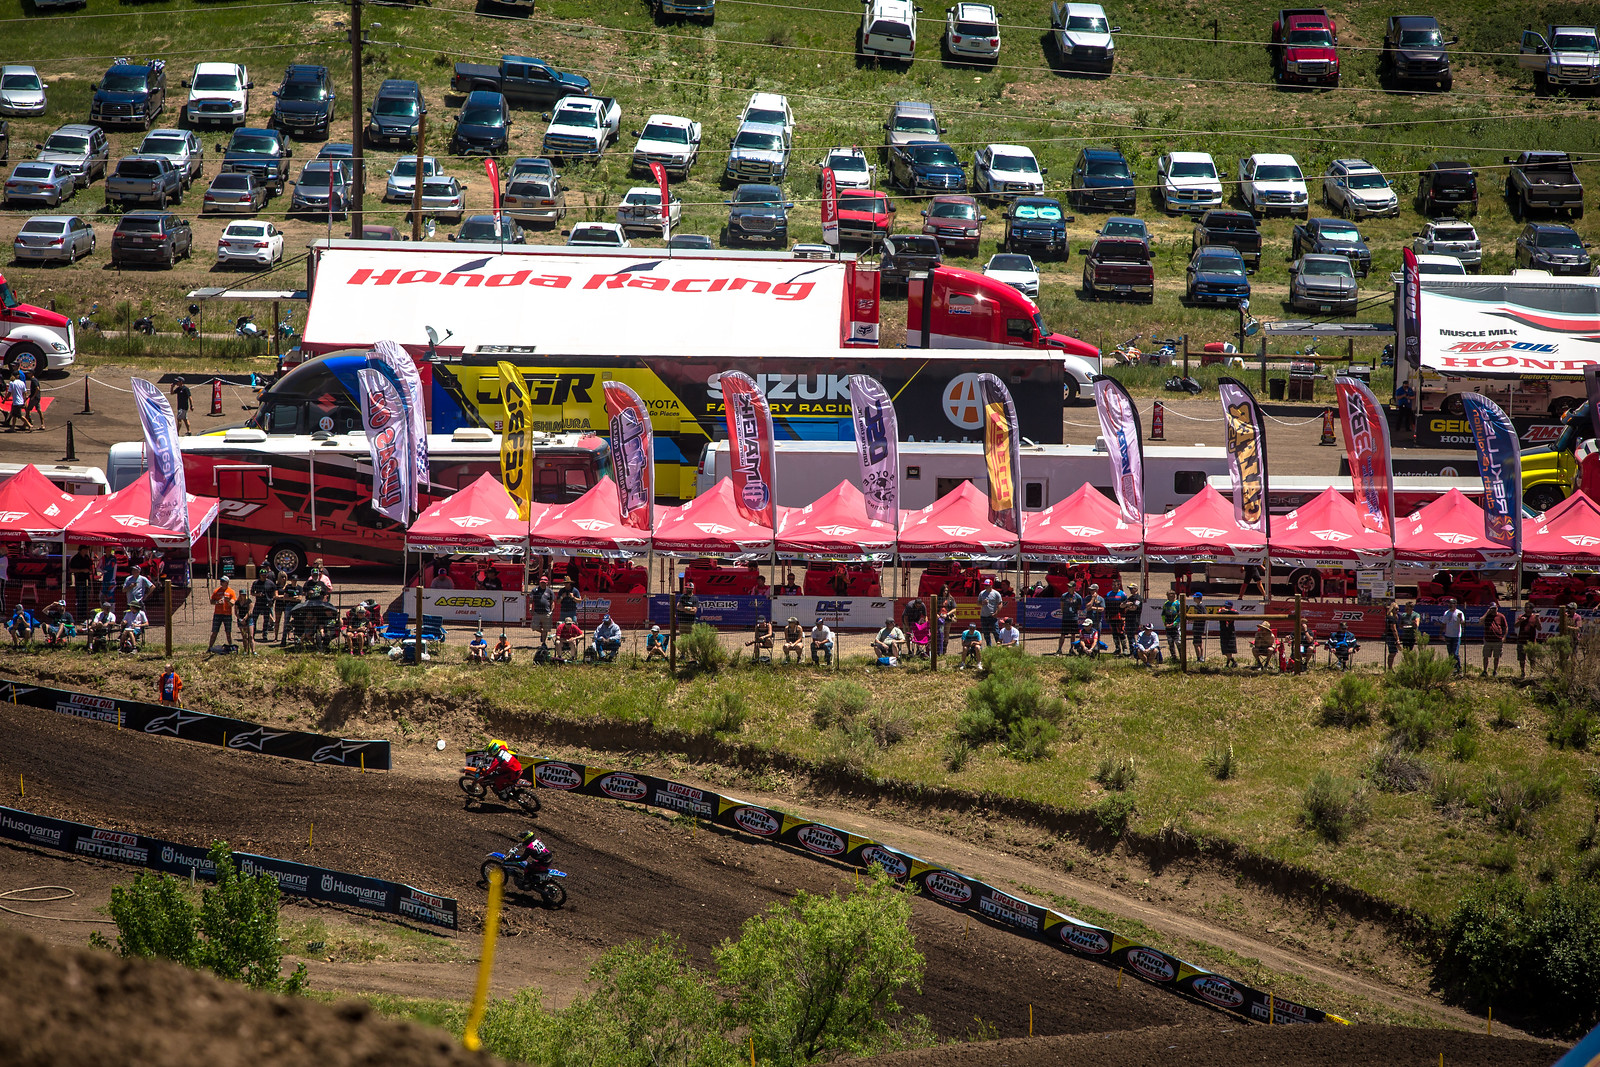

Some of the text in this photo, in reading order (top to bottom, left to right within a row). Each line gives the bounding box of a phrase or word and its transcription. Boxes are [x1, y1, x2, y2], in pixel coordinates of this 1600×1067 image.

[825, 170, 834, 221] HONDA
[347, 268, 816, 301] Honda Racing
[1405, 264, 1419, 321] 100%
[1439, 328, 1518, 337] MUSCLE MILK
[1447, 339, 1557, 354] AMSOIL
[1441, 356, 1598, 371] HOND
[477, 374, 596, 406] JGR
[707, 373, 851, 400] SZUK
[642, 399, 680, 409] OYOTA
[706, 403, 794, 412] FARY
[532, 417, 592, 432] SHIMURA
[1429, 419, 1473, 432] GEIC
[1440, 435, 1476, 444] HON
[1521, 425, 1566, 442] AMS
[706, 575, 737, 584] TPJ
[698, 600, 738, 609] MAGIK
[815, 600, 852, 612] DSC
[1332, 610, 1364, 622] 3BR
[1430, 616, 1481, 624] REUS
[71, 694, 113, 709] LUCAS OIL
[56, 705, 126, 724] MOTOCROSS
[540, 772, 577, 786] Works
[544, 766, 574, 778] Pivot
[605, 783, 644, 796] Works
[608, 776, 639, 788] Pivot
[668, 784, 702, 800] LUCAS OIL
[656, 792, 712, 814] MOTOCROSS
[739, 816, 774, 831] Works
[743, 809, 770, 824] Pivot
[2, 816, 61, 839] Husqvarna
[94, 830, 136, 845] LUCAS OIL
[802, 836, 840, 851] Works
[806, 828, 838, 844] Pivot
[76, 840, 148, 862] MOTOCROSS
[872, 848, 900, 866] Pivot
[174, 852, 217, 868] Husqvar
[867, 855, 902, 875] Wrks
[254, 864, 308, 886] Husqvarna
[936, 874, 966, 890] Pivot
[334, 880, 386, 900] Husqvarna
[930, 880, 968, 898] Works
[412, 892, 442, 908] LUCAS OIL
[994, 892, 1028, 912] LUCAS OIL
[400, 900, 454, 924] MOTOCROSS
[980, 900, 1038, 930] MOTOCROSS
[1065, 932, 1103, 951] Works
[1070, 927, 1100, 942] Pivot
[1132, 956, 1168, 978] Works
[1136, 950, 1166, 968] Pivot
[1198, 984, 1239, 1004] Works
[1204, 978, 1235, 996] Pivot
[1292, 1004, 1304, 1016] OIL
